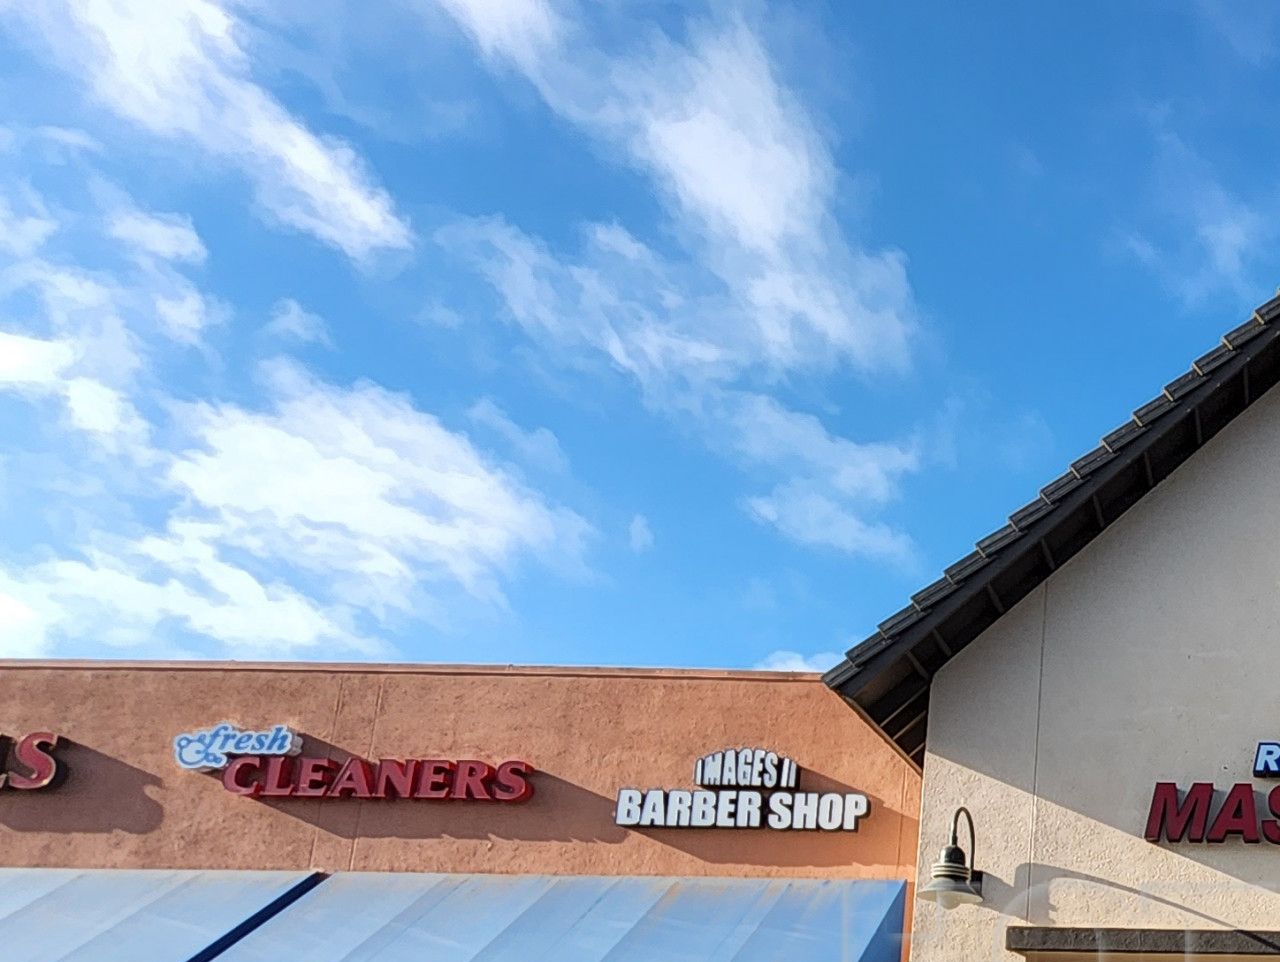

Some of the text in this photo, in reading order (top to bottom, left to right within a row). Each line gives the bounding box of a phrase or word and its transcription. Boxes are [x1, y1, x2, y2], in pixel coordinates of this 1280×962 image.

[222, 756, 534, 801] CLEANERS
[695, 749, 778, 788] IMAGES
[615, 788, 868, 831] BARBER SHOP
